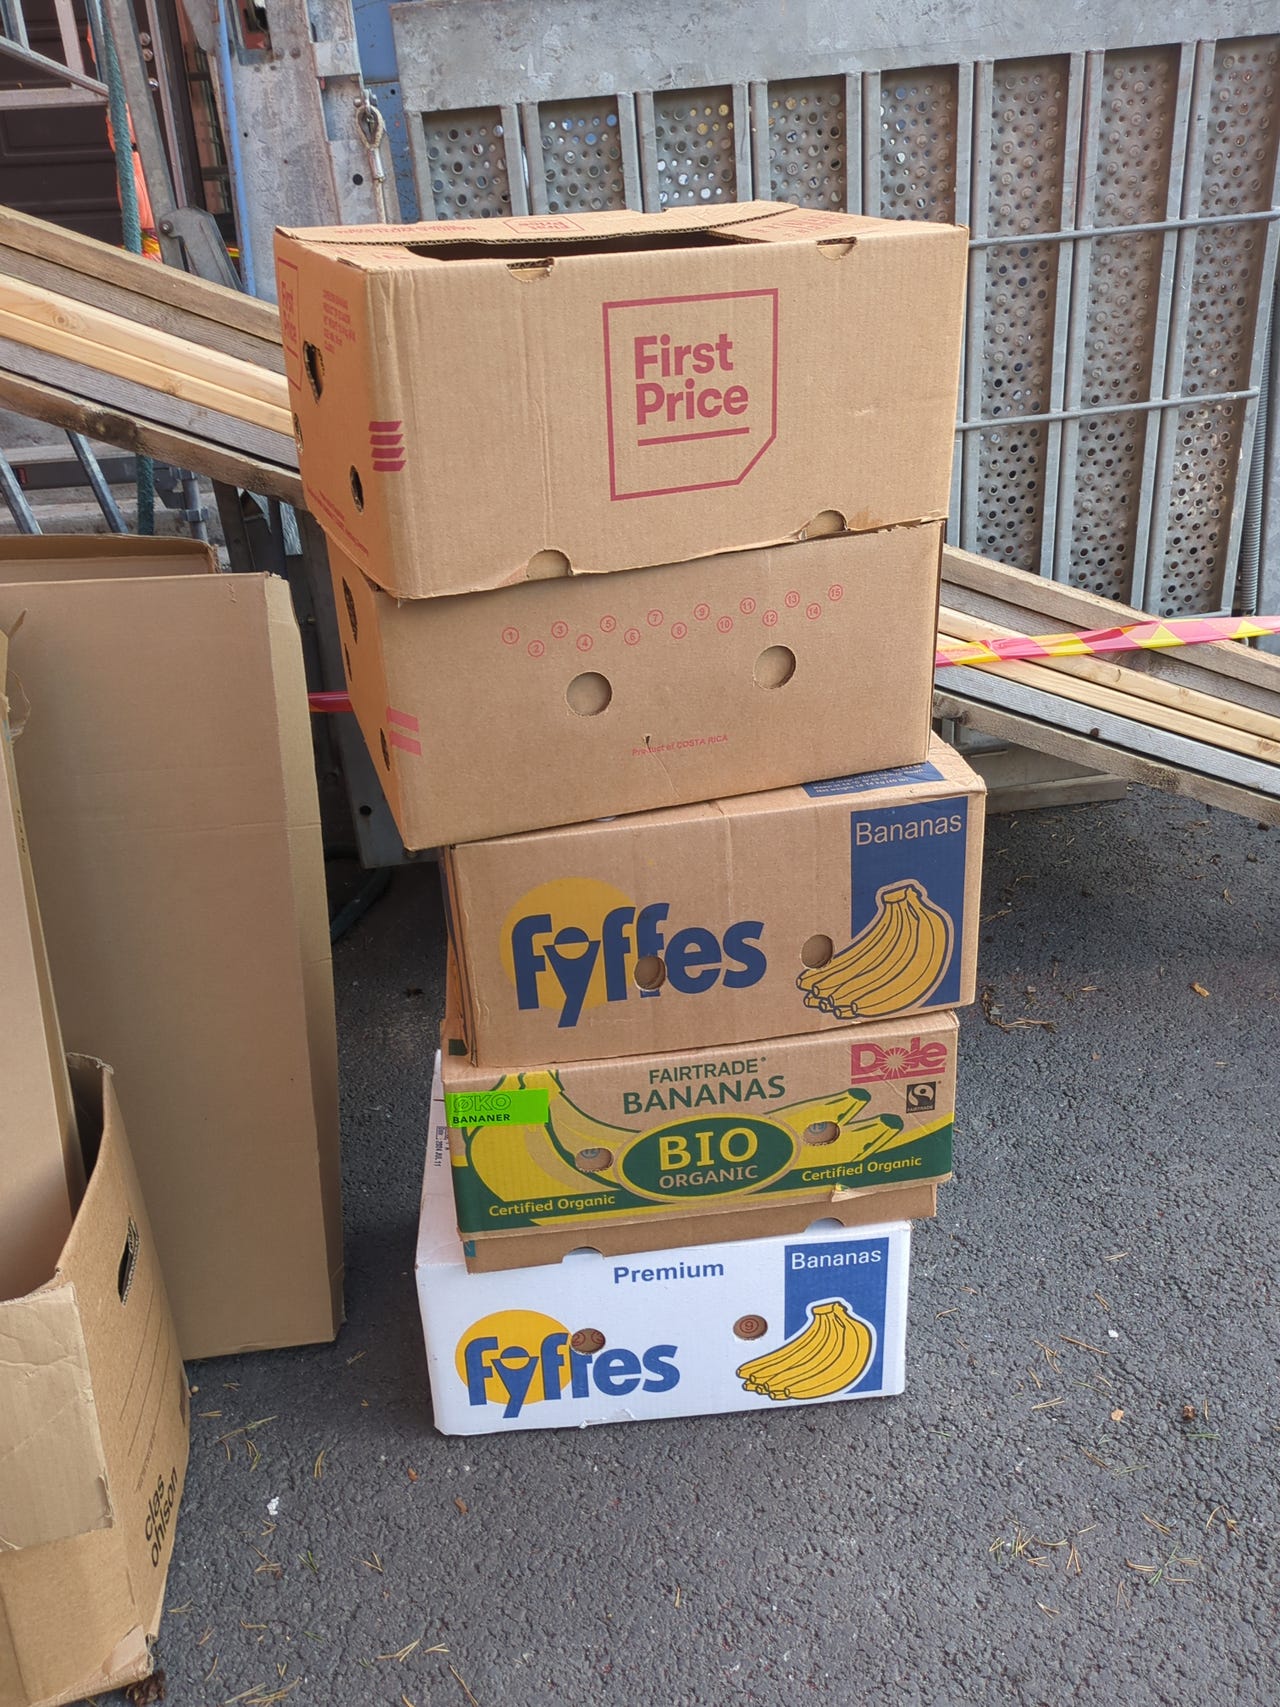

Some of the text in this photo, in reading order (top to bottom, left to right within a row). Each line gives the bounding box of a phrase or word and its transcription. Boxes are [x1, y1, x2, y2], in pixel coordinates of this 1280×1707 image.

[634, 333, 734, 380] First
[635, 377, 749, 425] Price
[666, 742, 676, 751] of
[676, 738, 706, 749] COSTA
[708, 735, 728, 744] RICA
[855, 813, 962, 846] Bananas
[511, 902, 768, 1029] fyffes
[649, 1058, 758, 1085] FAIRTRADE
[850, 1037, 948, 1073] Dole
[453, 1093, 512, 1114] ØKO
[623, 1074, 786, 1115] BANANAS
[452, 1113, 511, 1124] BANANER
[659, 1127, 758, 1171] BIO
[659, 1165, 759, 1189] ORGANIC
[802, 1156, 922, 1182] Certified Organic
[488, 1194, 615, 1217] Certified Organic
[613, 1261, 725, 1285] Premium
[790, 1249, 882, 1271] Bananas
[464, 1332, 680, 1419] fyffes
[145, 1474, 165, 1541] clas
[151, 1466, 178, 1568] ohlson
